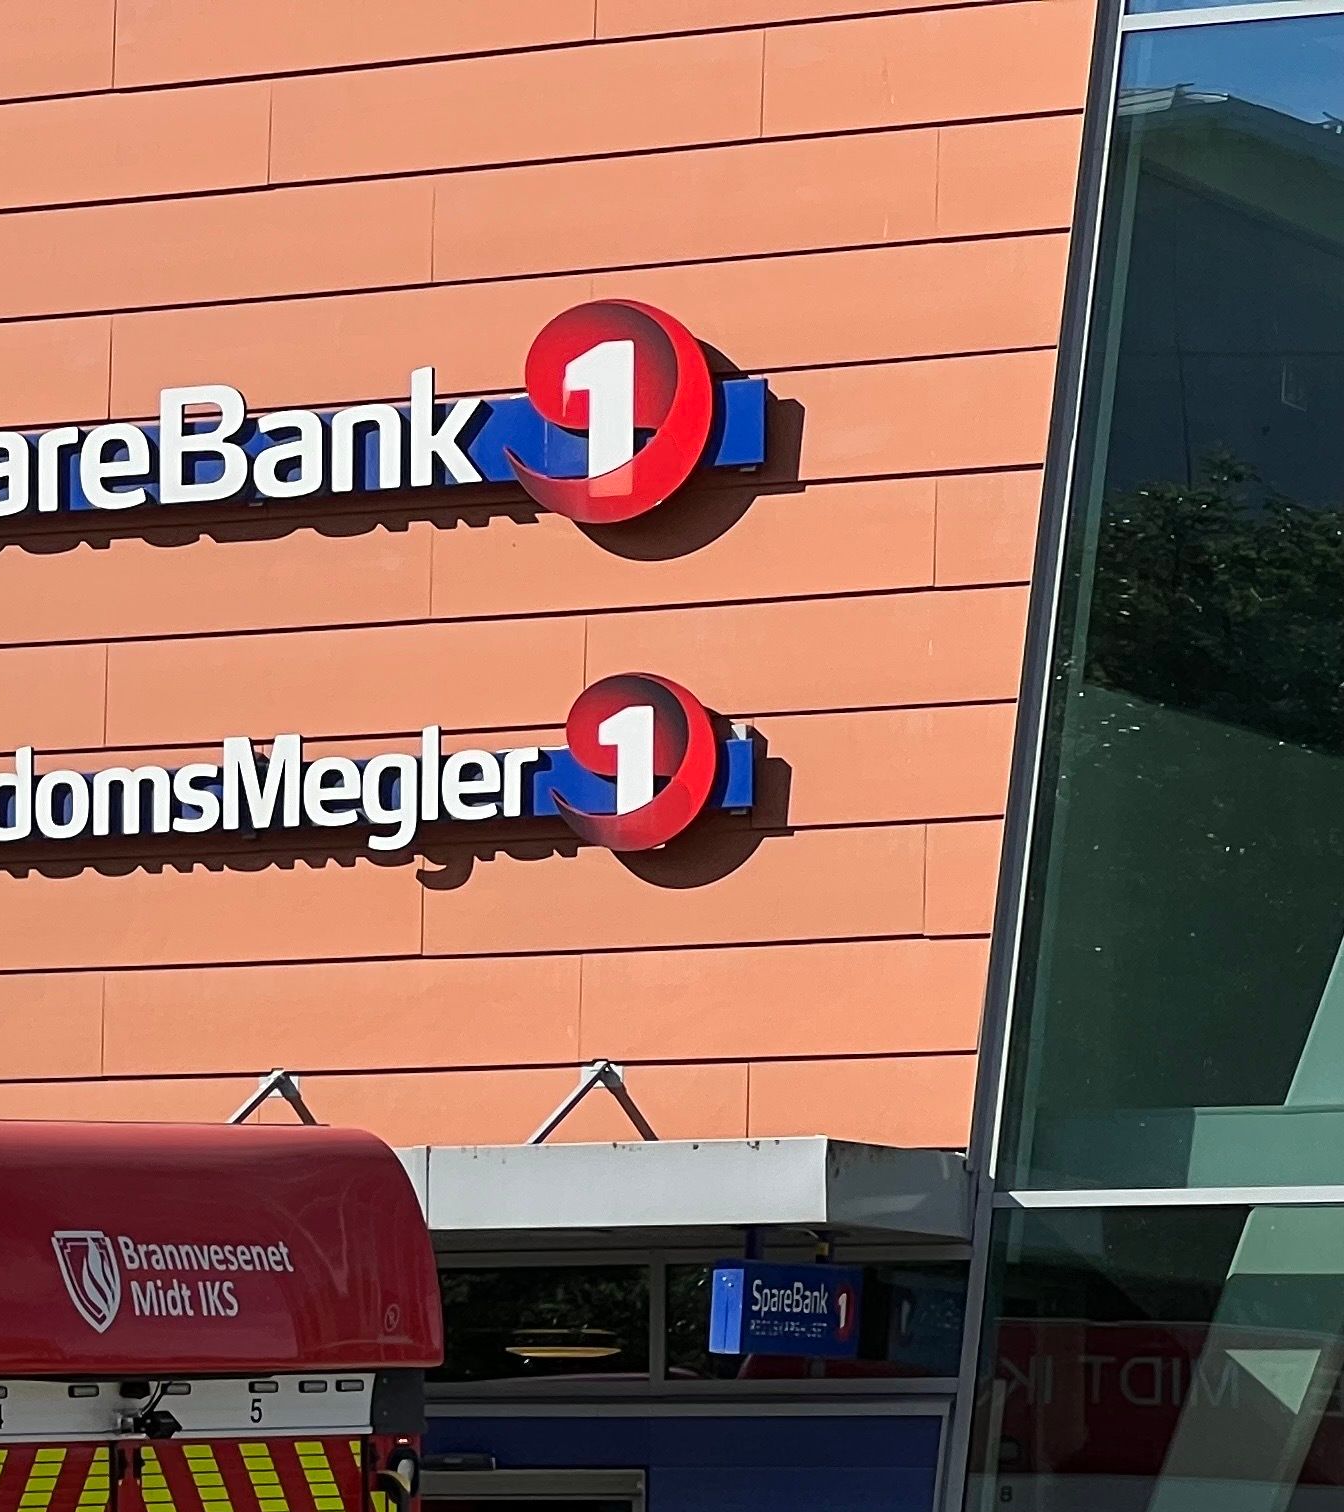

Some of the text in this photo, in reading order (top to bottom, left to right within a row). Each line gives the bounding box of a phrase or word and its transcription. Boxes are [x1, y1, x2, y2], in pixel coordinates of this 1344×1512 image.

[565, 340, 636, 480] 1
[598, 705, 654, 816] 1
[118, 1235, 294, 1272] Brannvesenet
[131, 1281, 238, 1318] Midt IKS
[752, 1279, 829, 1318] SpareBank
[837, 1292, 848, 1329] 1
[249, 1398, 263, 1424] 5
